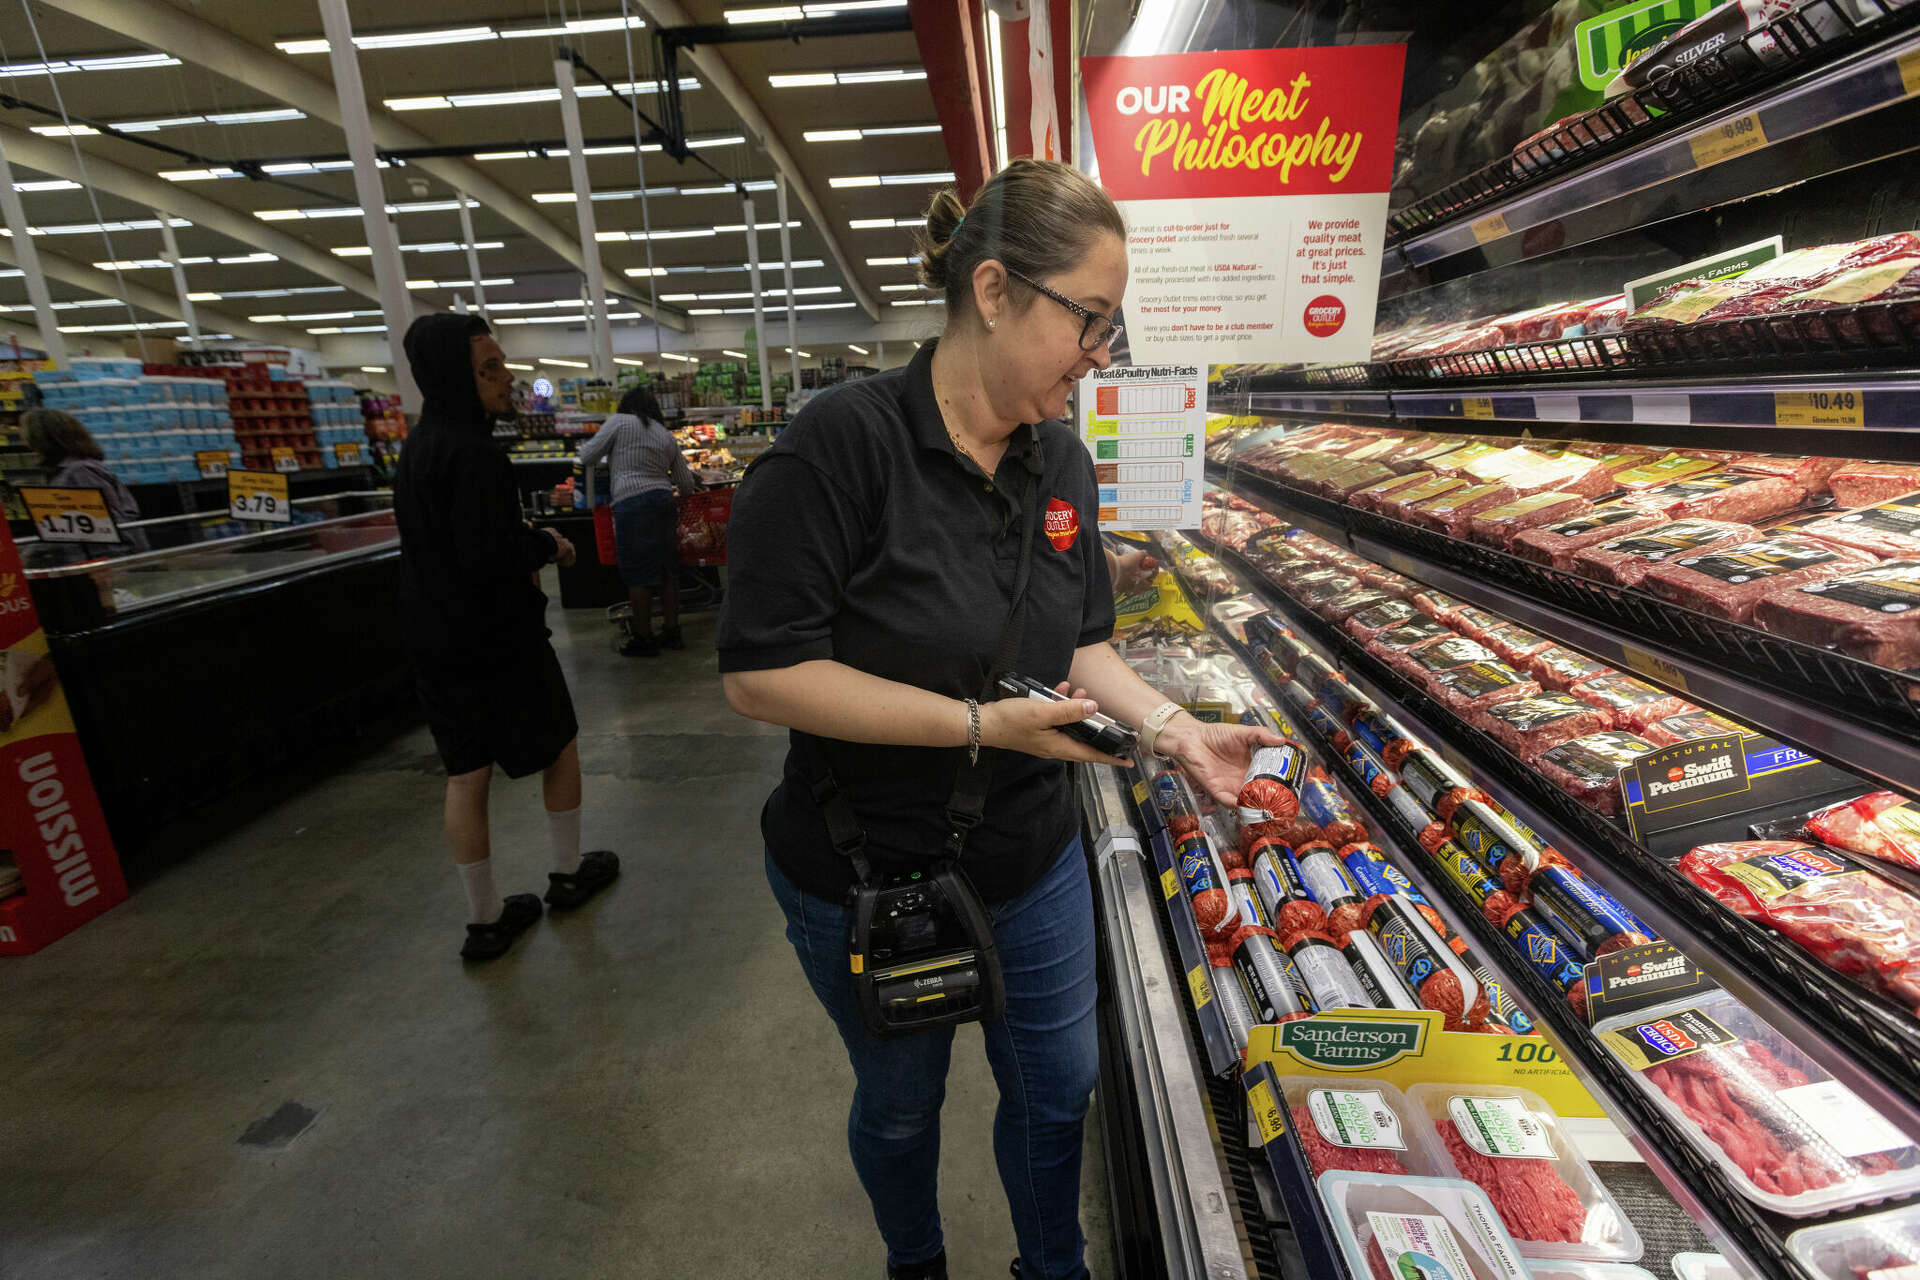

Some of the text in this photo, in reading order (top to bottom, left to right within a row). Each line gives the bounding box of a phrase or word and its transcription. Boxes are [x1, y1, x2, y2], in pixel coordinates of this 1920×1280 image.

[1675, 32, 1726, 66] SILVER
[1116, 68, 1311, 130] OUR Meat
[1134, 116, 1363, 184] Philosophy
[1163, 224, 1204, 232] cut-to-order
[1205, 223, 1218, 233] just
[1220, 223, 1230, 231] for
[1308, 219, 1360, 232] We provide
[1128, 236, 1154, 244] Grocery
[1156, 235, 1176, 243] Outlet
[1237, 232, 1260, 240] several
[1304, 232, 1362, 245] quality meat
[1296, 246, 1366, 259] at great prices.
[1312, 260, 1346, 272] It's just
[1136, 276, 1162, 284] minimally
[1164, 276, 1196, 284] processed
[1302, 274, 1356, 285] that simple.
[1656, 260, 1749, 294] THAS FARMS
[1139, 296, 1162, 304] Grocery
[1256, 294, 1267, 302] get
[1154, 334, 1164, 342] buy
[1204, 334, 1213, 342] get
[1220, 334, 1236, 342] great
[1160, 326, 1170, 334] you
[1172, 324, 1188, 332] don't
[1151, 366, 1198, 377] Nutri-Facts
[1185, 388, 1196, 408] Beef
[1184, 434, 1194, 458] Lamb
[1182, 478, 1194, 504] Turkey
[236, 494, 276, 514] 3.79
[46, 514, 94, 534] 1.79
[1045, 509, 1072, 521] ROCERY
[1648, 742, 1731, 766] NATURAL
[1684, 755, 1733, 778] Swift
[1648, 769, 1735, 797] Premium
[1642, 956, 1686, 974] Swift
[923, 976, 943, 986] ZEBRA
[1608, 967, 1686, 989] Premium
[1292, 1025, 1407, 1044] Sanderson
[1656, 1024, 1687, 1048] USDA
[1681, 1012, 1721, 1042] Premium
[1641, 1026, 1680, 1053] CHOICE
[1313, 1042, 1381, 1059] Farms
[1496, 1042, 1557, 1062] 100
[1337, 1103, 1356, 1134] BEEF
[1344, 1094, 1370, 1144] GROUND
[1480, 1110, 1504, 1142] BEEF
[1484, 1100, 1520, 1152] GROUND
[1474, 1203, 1498, 1245] THOMAS
[1495, 1243, 1516, 1276] FARMS
